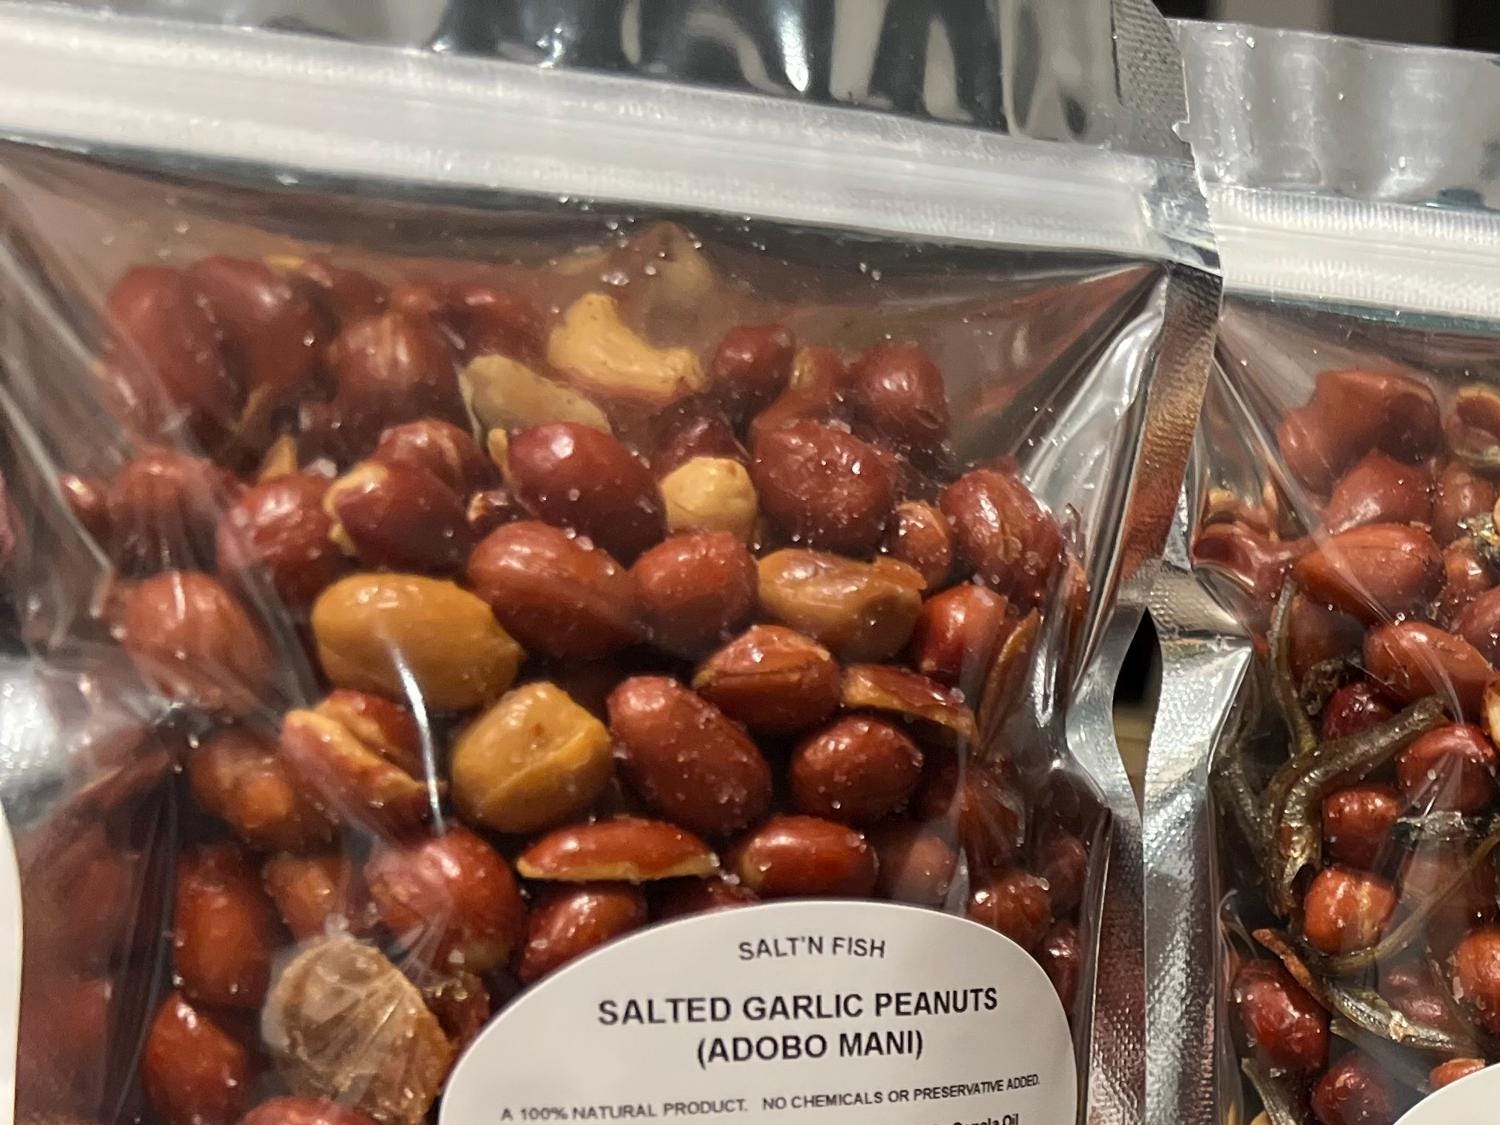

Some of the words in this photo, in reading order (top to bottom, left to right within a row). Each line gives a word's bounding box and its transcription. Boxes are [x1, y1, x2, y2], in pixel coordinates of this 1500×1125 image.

[738, 936, 823, 960] SALT'N
[832, 937, 885, 959] FISH
[598, 997, 732, 1026] SALTED
[742, 994, 863, 1021] GARLIC
[875, 987, 997, 1017] PEANUTS
[697, 1034, 827, 1070] (ADOBO
[839, 1030, 923, 1060] MANI)
[501, 1108, 513, 1121] A
[520, 1107, 568, 1120] 100%
[572, 1104, 657, 1119] NATURAL
[663, 1098, 747, 1116] PRODUCT.
[762, 1096, 787, 1110] NO
[791, 1091, 883, 1109] CHEMICALS
[888, 1090, 909, 1103] OR
[914, 1079, 1004, 1101] PRESERVATIVE
